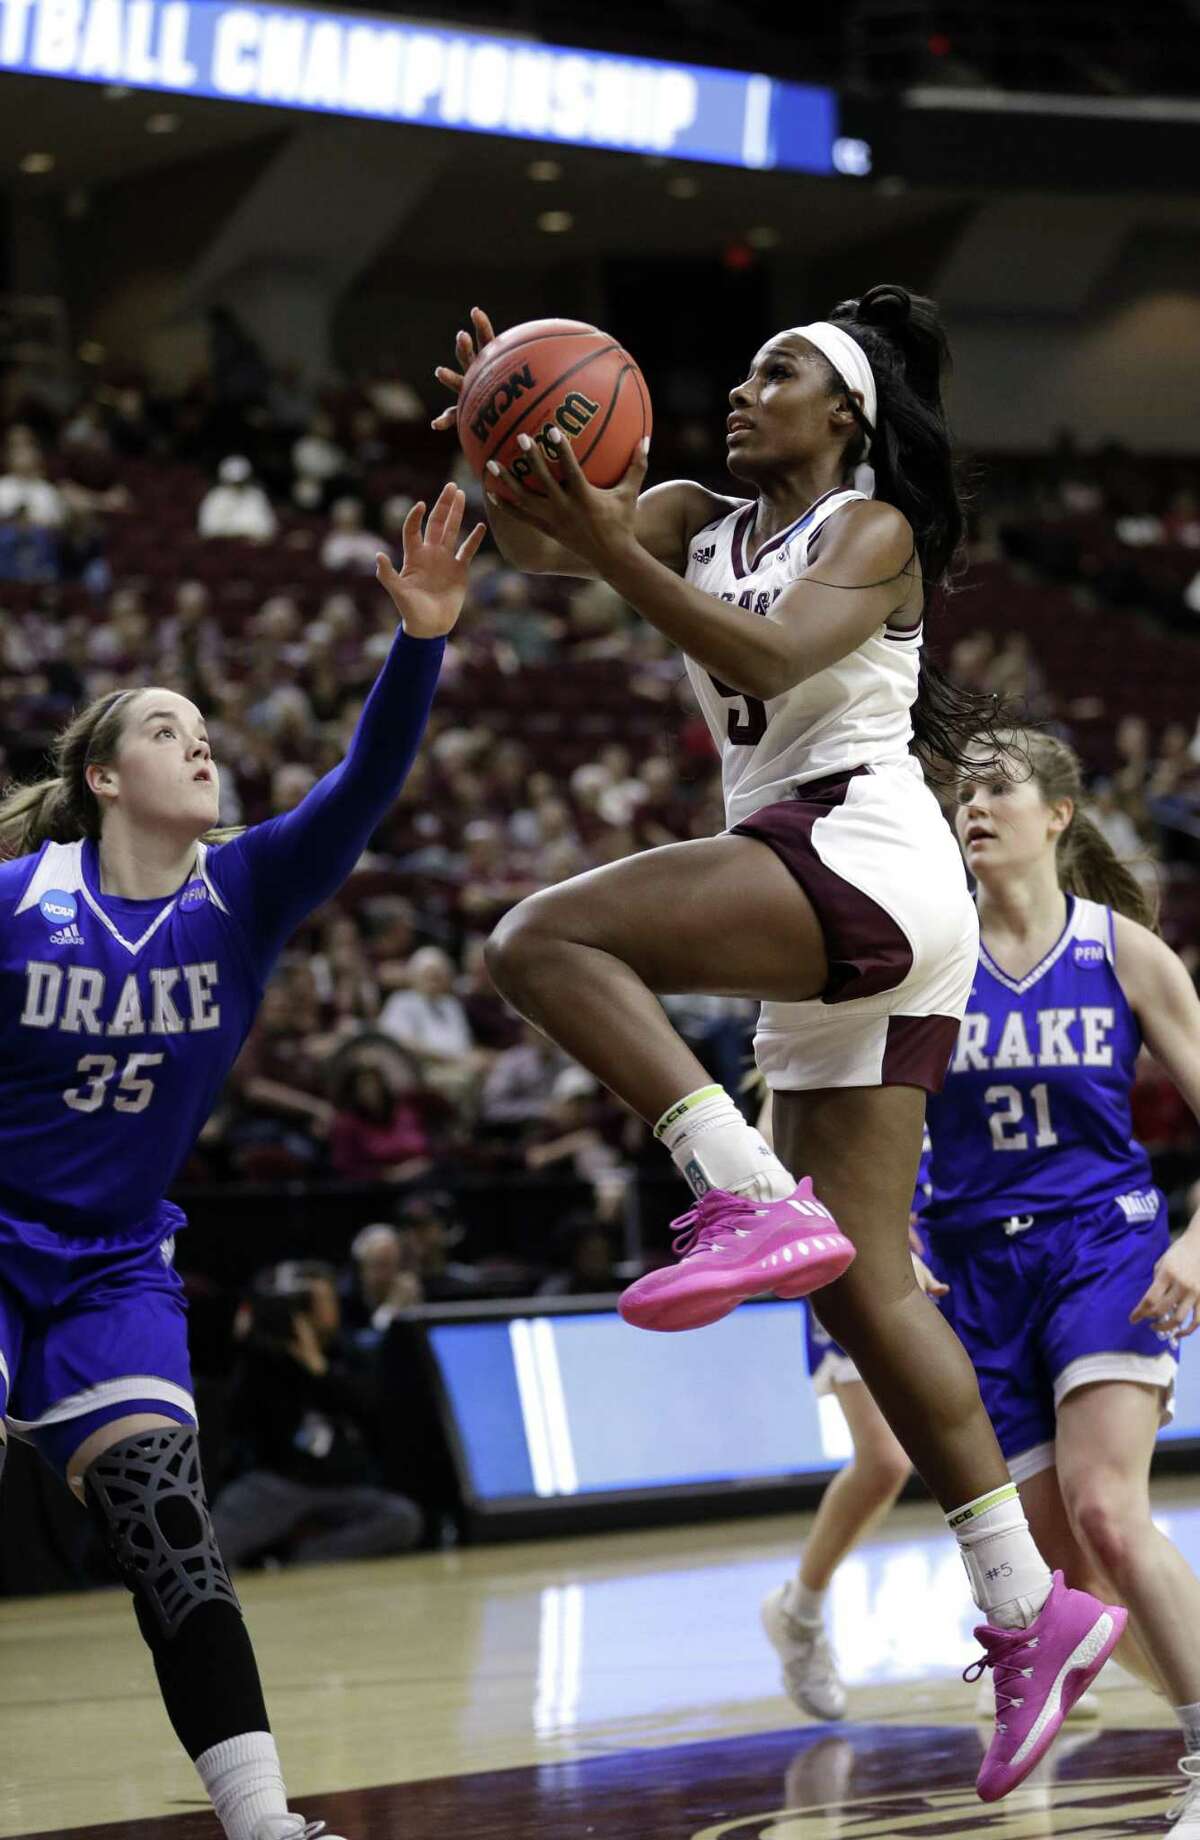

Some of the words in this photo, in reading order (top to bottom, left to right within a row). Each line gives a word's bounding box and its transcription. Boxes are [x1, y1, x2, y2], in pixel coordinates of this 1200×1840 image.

[211, 10, 697, 151] CHAMPIONSHIP
[44, 902, 74, 918] NCAA
[50, 935, 84, 945] adidas
[20, 960, 220, 1036] DRAKE
[951, 1007, 1114, 1072] RAKE
[63, 1052, 164, 1113] 35
[984, 1083, 1058, 1151] 21
[985, 1562, 1013, 1581] #5
